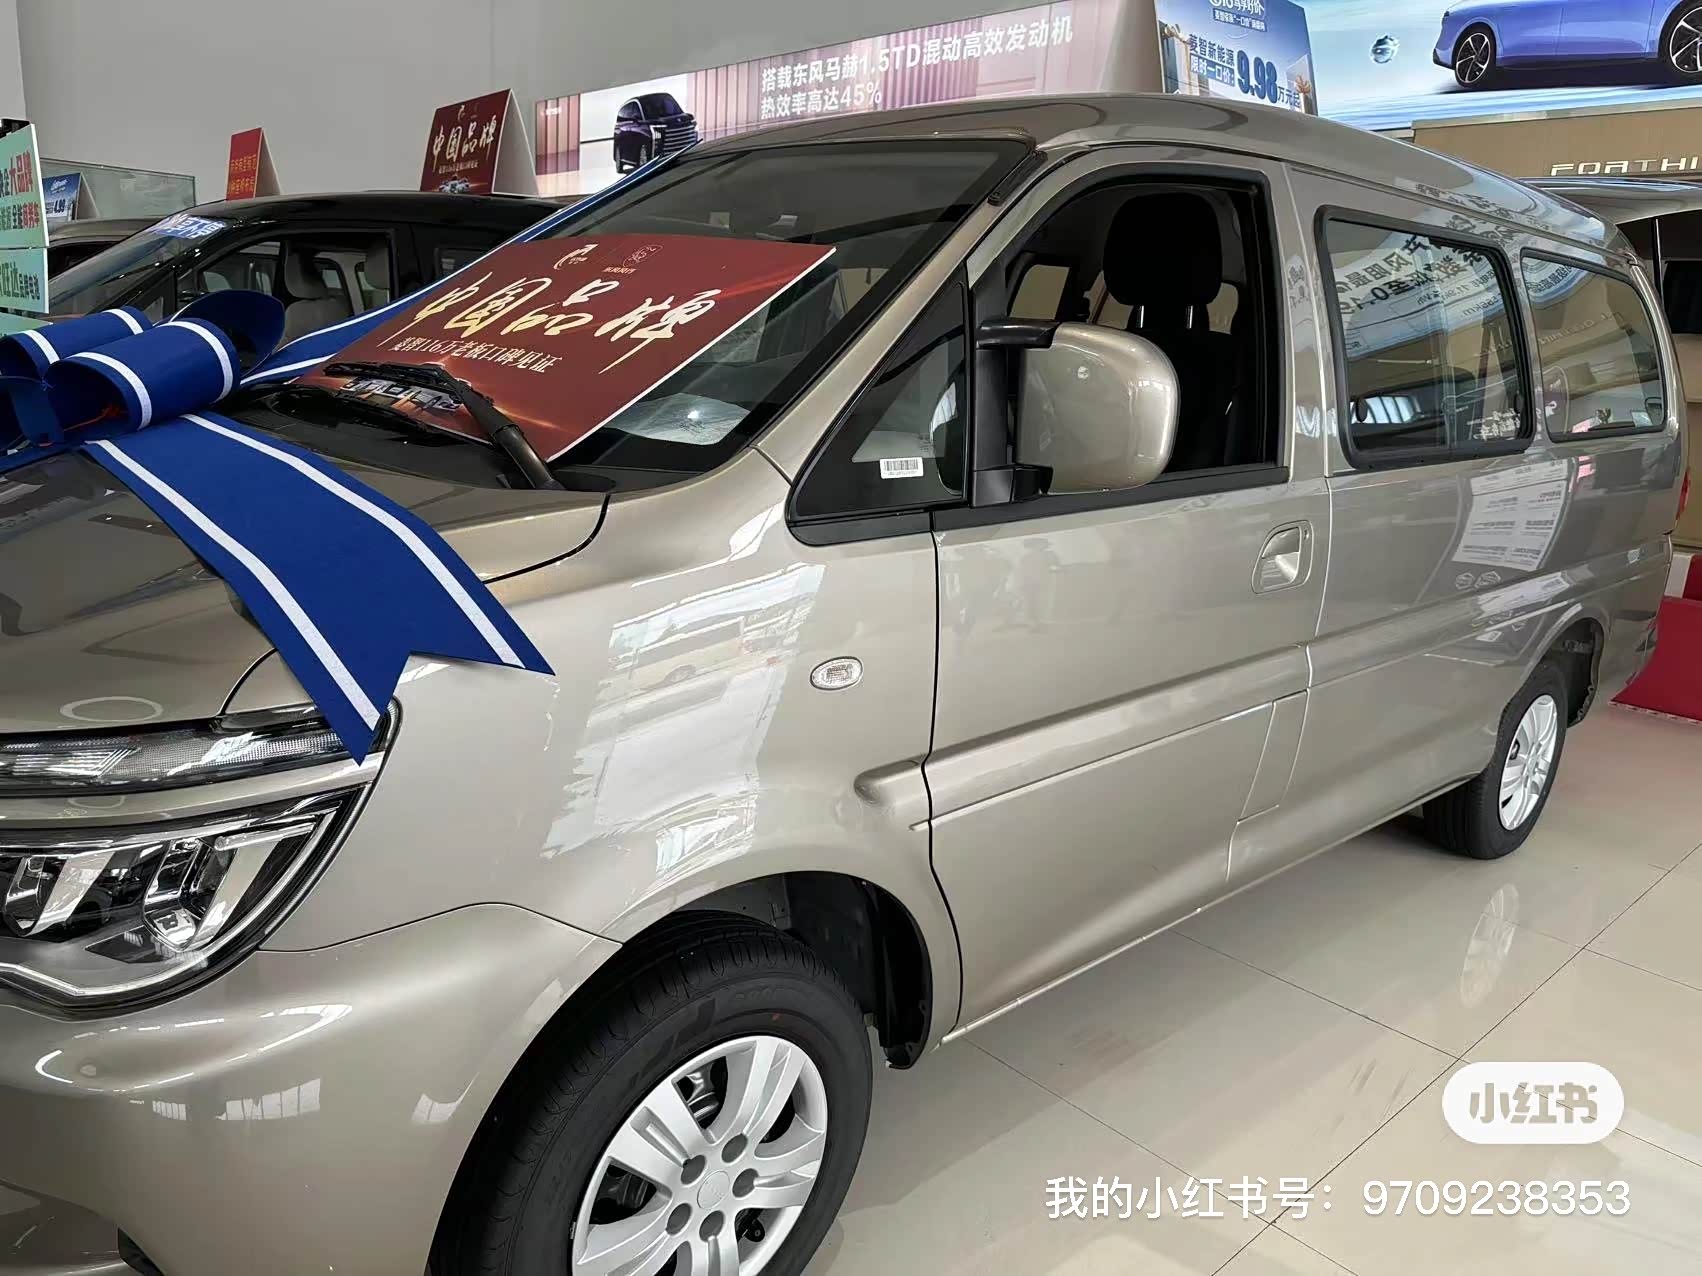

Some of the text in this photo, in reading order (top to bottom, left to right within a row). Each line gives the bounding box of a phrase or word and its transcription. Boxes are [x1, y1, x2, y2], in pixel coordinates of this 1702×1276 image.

[761, 15, 1074, 94] 搭载东风马赫1.5TD混动高效发动机
[1188, 33, 1235, 67] 菱智新能源
[760, 79, 883, 120] 热效率高达45%
[376, 272, 721, 374] 中国品牌
